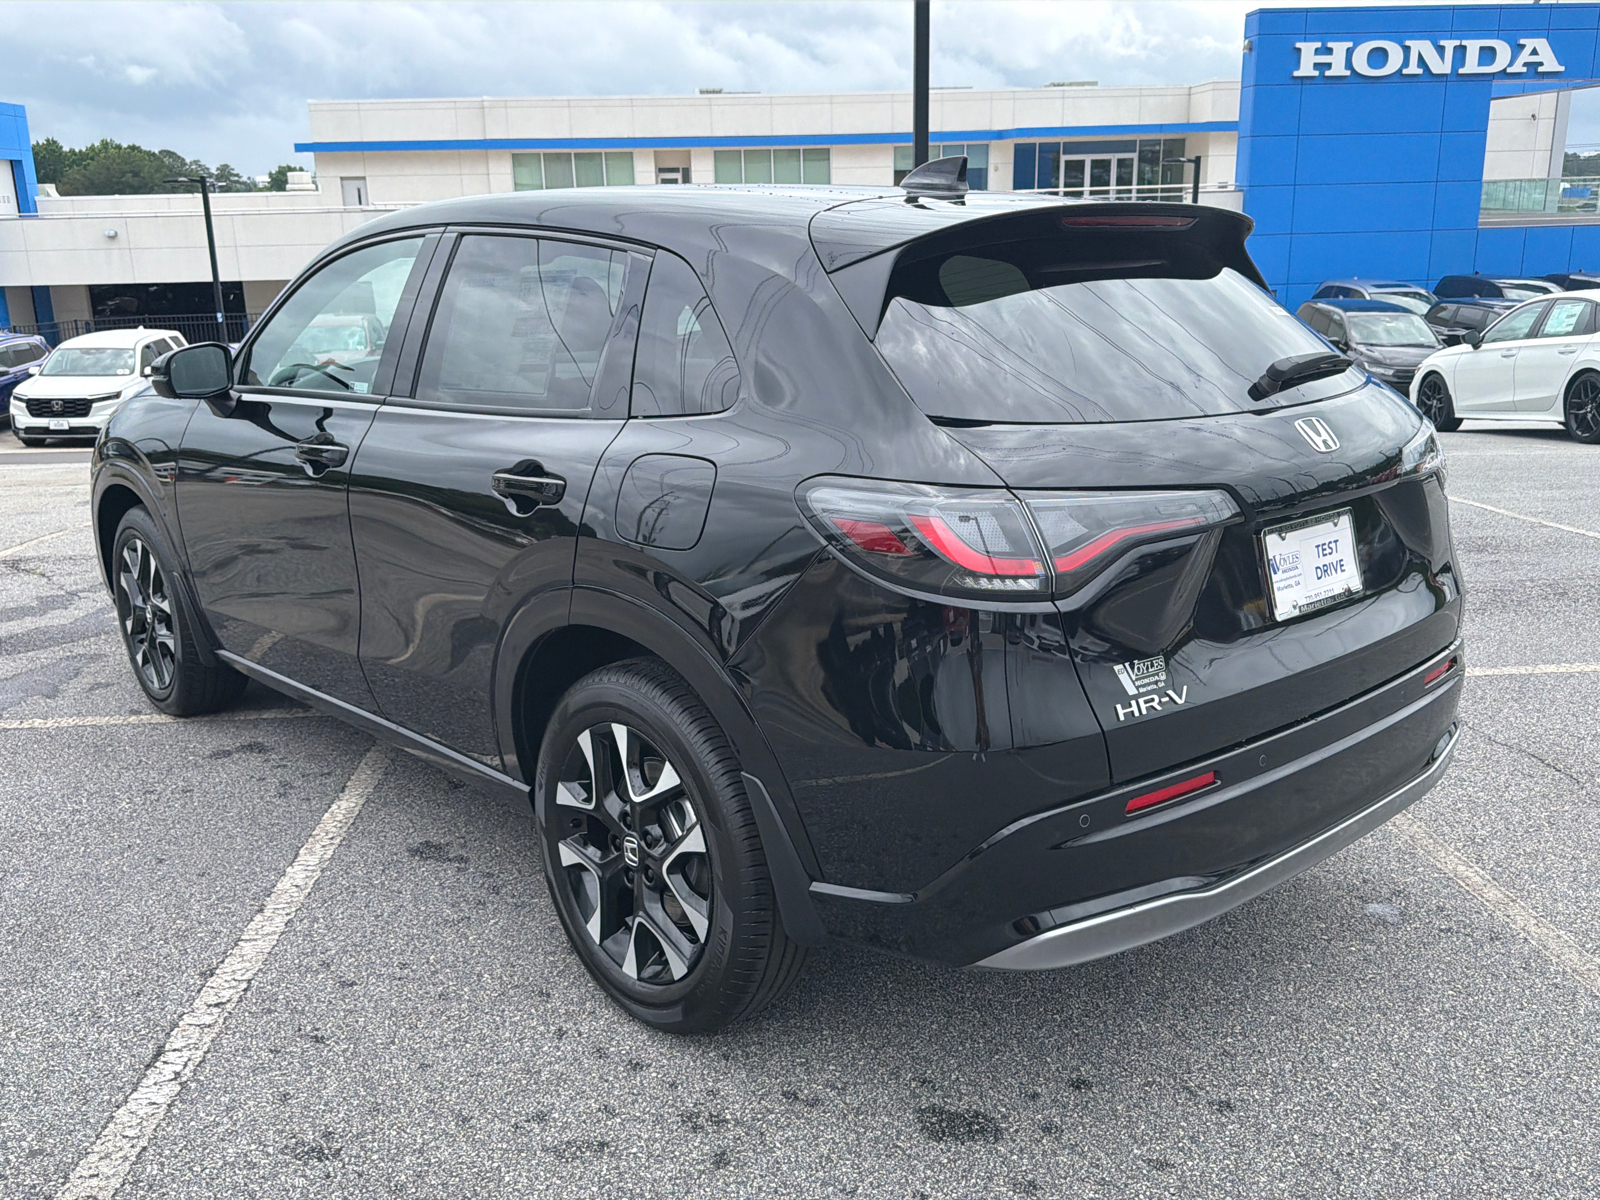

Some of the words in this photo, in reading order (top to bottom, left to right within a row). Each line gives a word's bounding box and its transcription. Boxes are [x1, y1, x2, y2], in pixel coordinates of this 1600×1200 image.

[1293, 38, 1566, 78] HONDA
[1315, 539, 1339, 559] TEST
[1272, 552, 1300, 572] VOYLES
[1281, 565, 1299, 574] HONDA
[1315, 558, 1346, 581] DRIVE
[1124, 658, 1164, 681] VOYLES
[1135, 675, 1160, 686] HONDA
[1115, 685, 1188, 721] HR-V
